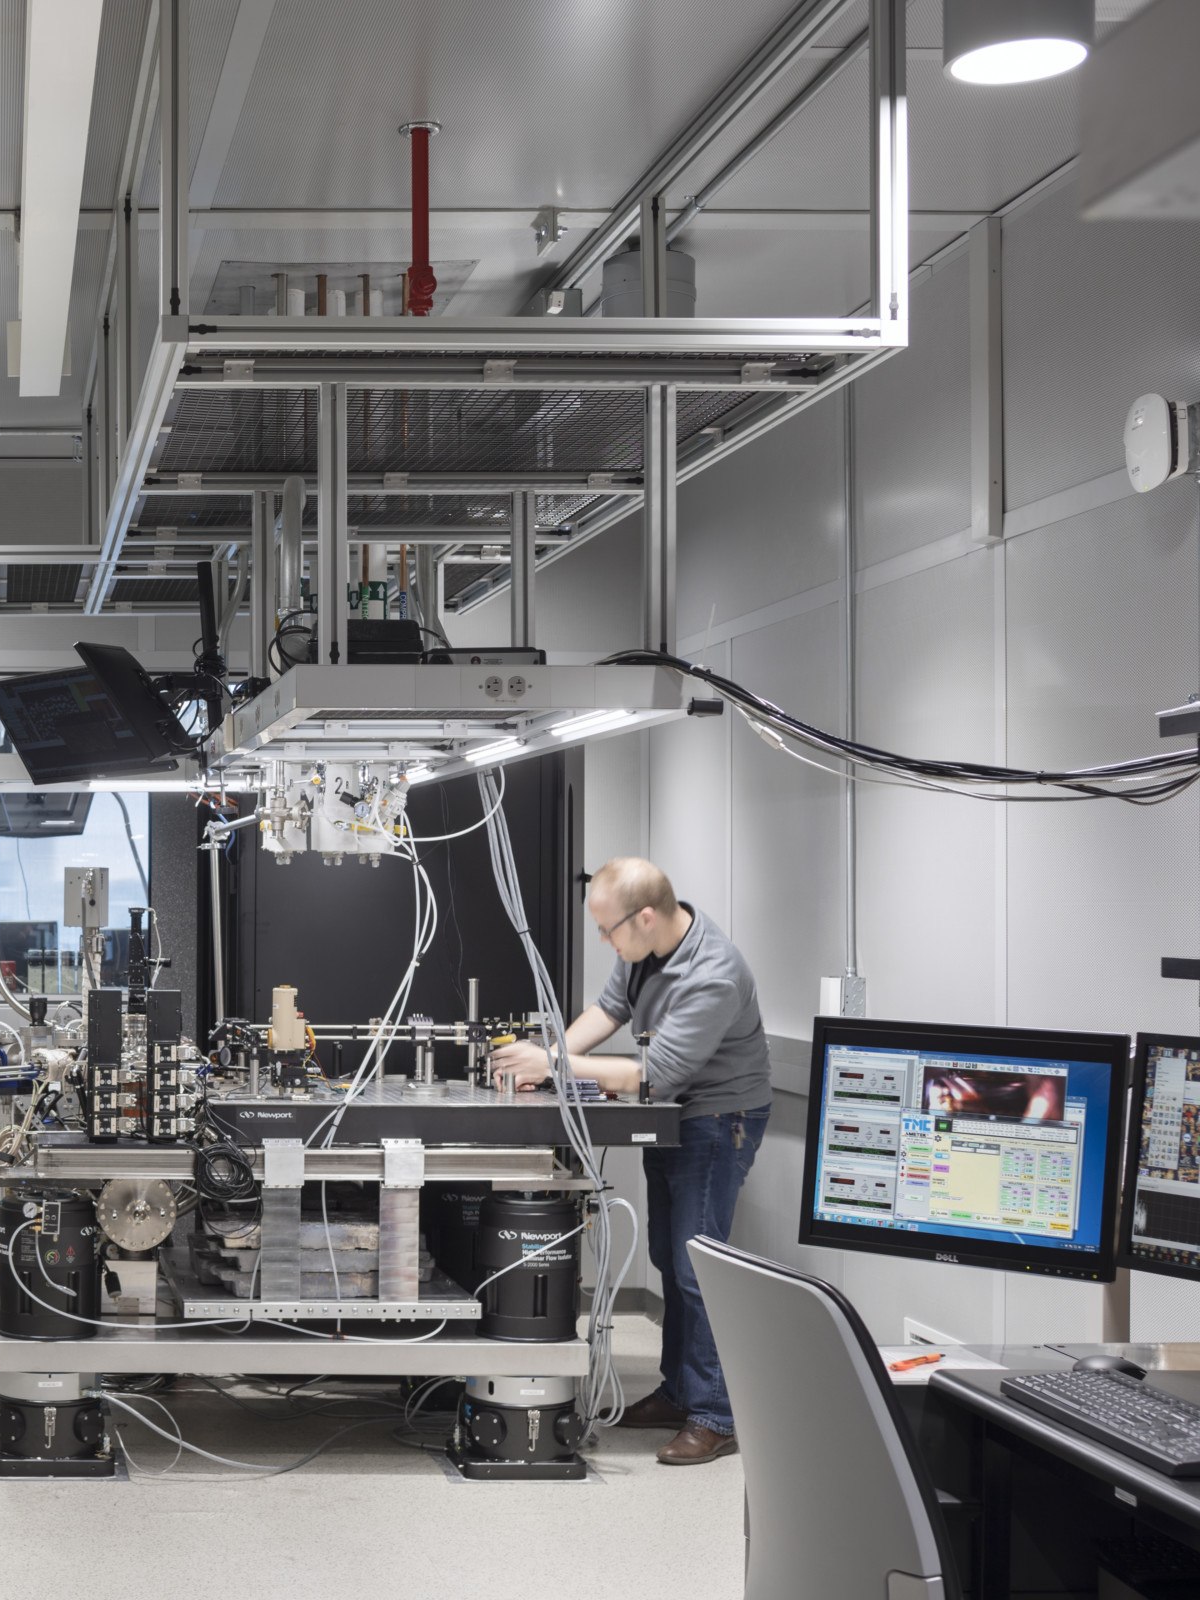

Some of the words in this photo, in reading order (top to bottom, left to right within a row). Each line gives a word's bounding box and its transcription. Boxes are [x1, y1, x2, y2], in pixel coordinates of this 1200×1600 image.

[335, 776, 343, 794] 2
[257, 1111, 293, 1119] Newport
[902, 1118, 931, 1131] TMC
[521, 1232, 562, 1241] Newport
[935, 1252, 959, 1263] DELL
